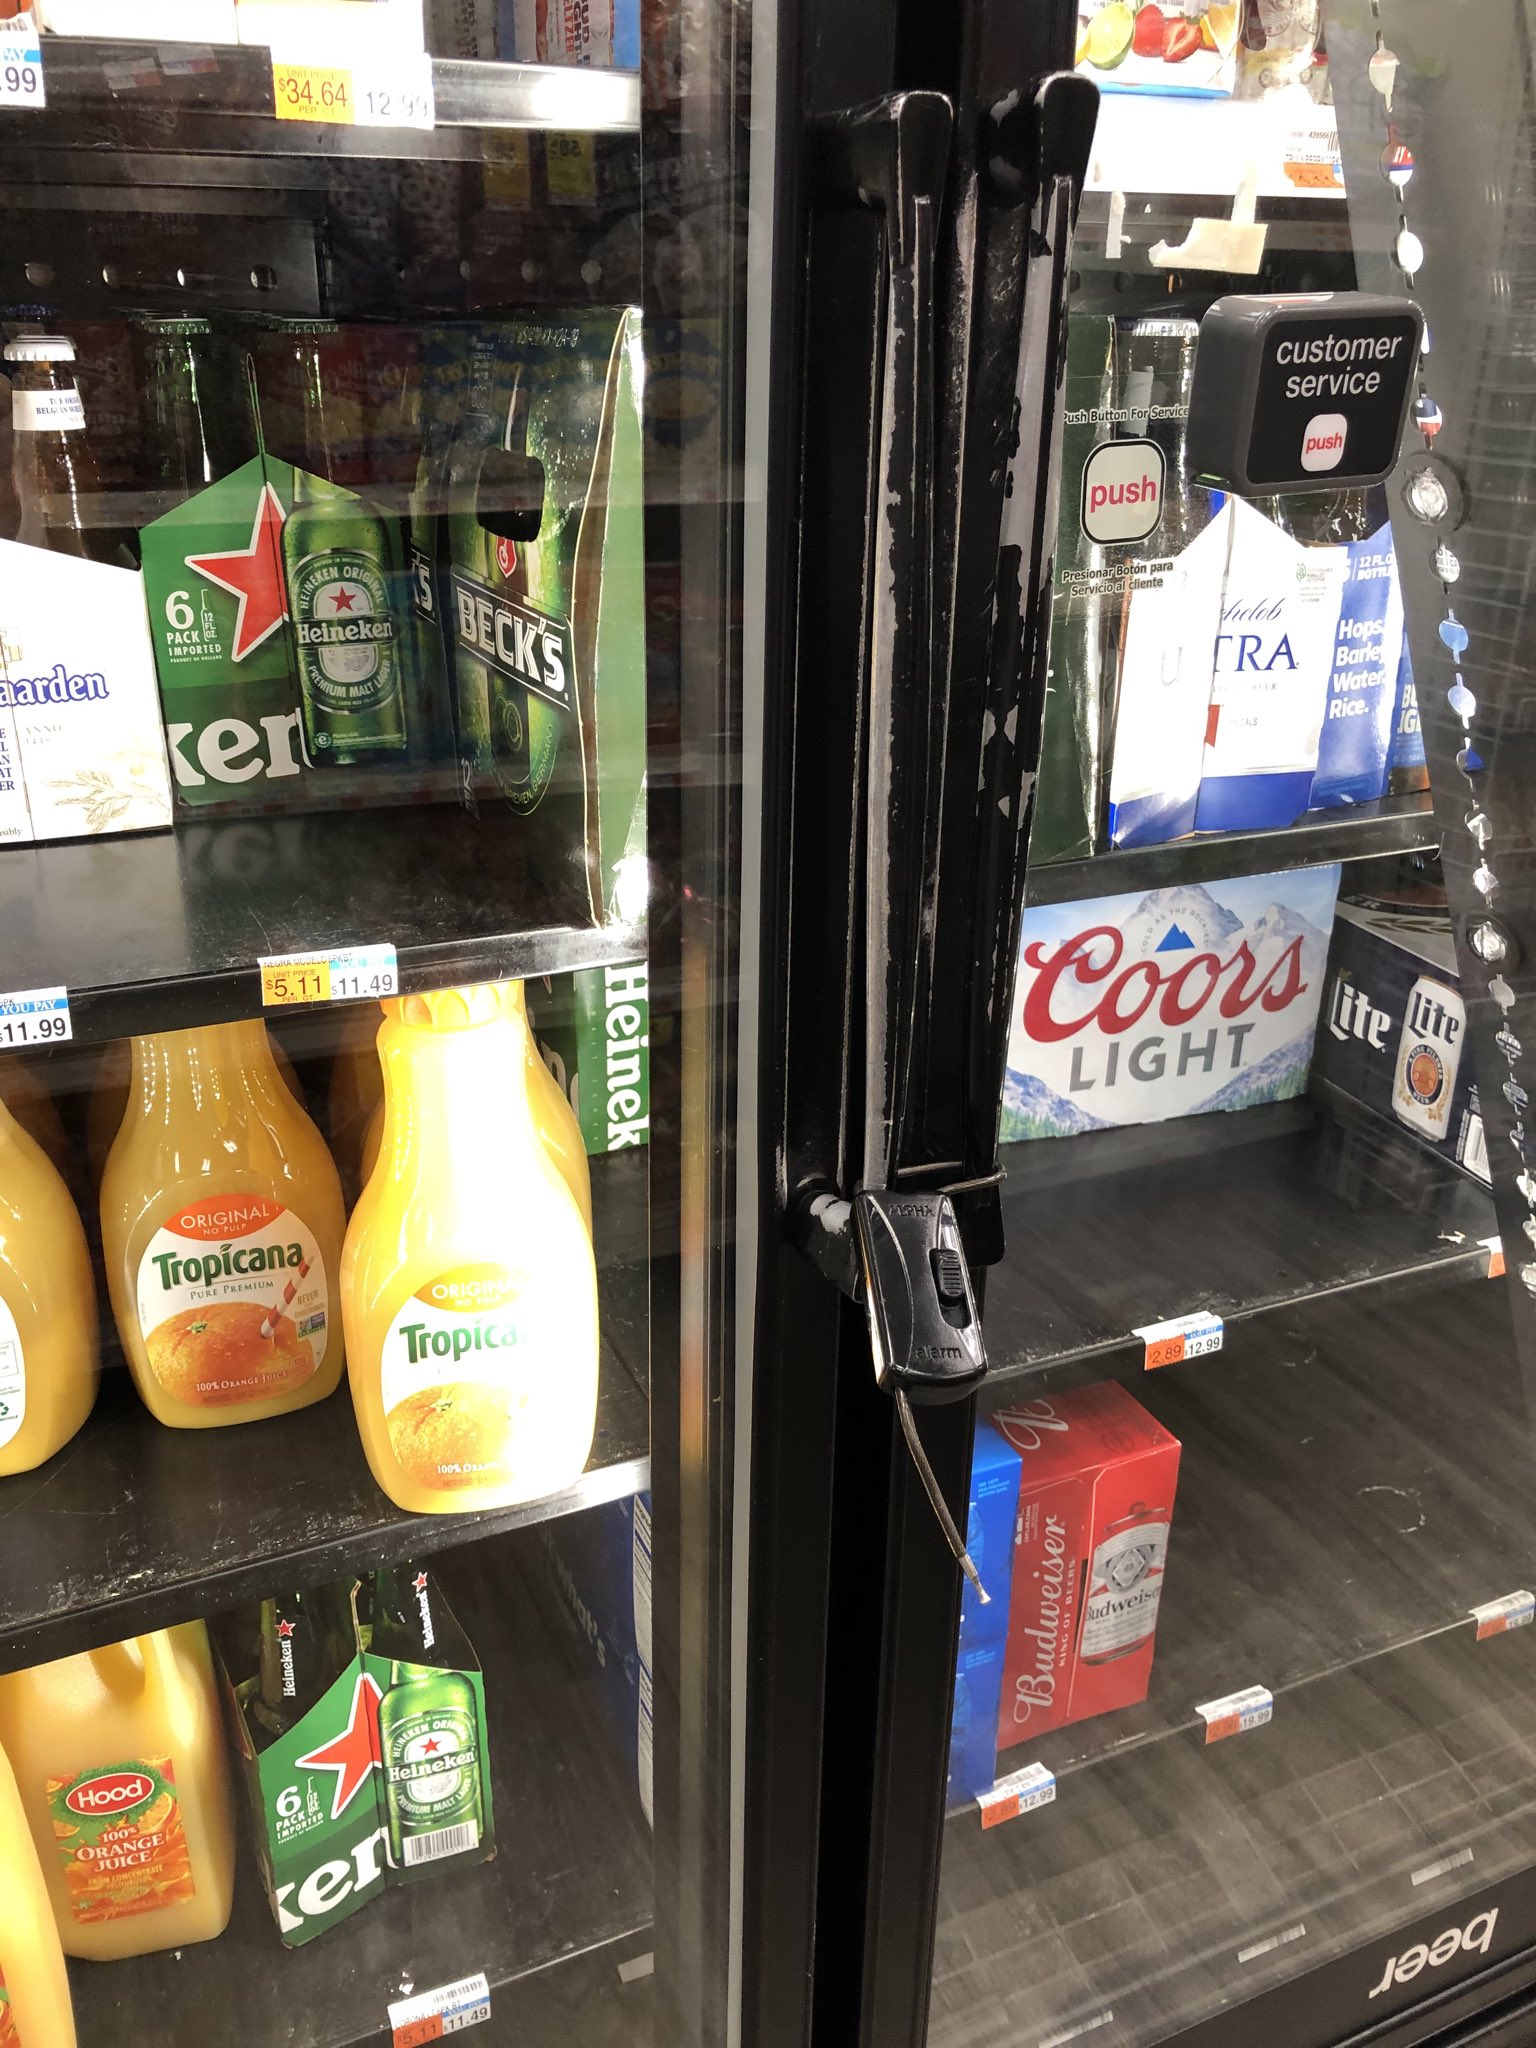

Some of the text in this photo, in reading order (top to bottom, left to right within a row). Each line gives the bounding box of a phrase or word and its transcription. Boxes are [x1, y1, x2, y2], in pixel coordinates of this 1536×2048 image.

[278, 78, 347, 107] $34.64
[299, 105, 317, 114] PER
[1276, 334, 1403, 365] customer
[1285, 366, 1380, 399] service
[1090, 408, 1127, 423] Button
[1131, 405, 1149, 420] For
[1150, 403, 1190, 419] Service
[1306, 432, 1343, 454] push
[1090, 475, 1157, 514] push
[1062, 561, 1174, 583] Presionar Botón para
[301, 566, 339, 611] HEINEKEN
[1071, 577, 1163, 598] Servicio al cliente
[166, 590, 195, 630] 6
[204, 612, 215, 622] 12
[166, 630, 200, 645] PACK
[297, 620, 393, 644] Heineken
[457, 586, 565, 693] BECK'S
[168, 643, 222, 657] IMPORTED
[308, 665, 346, 697] PREMIUM
[349, 682, 374, 698] MALT
[1329, 699, 1369, 719] Rice.
[266, 974, 392, 997] $5.11 $11.49
[273, 970, 290, 978] UNIT
[1023, 925, 1309, 1043] Coors
[1, 1000, 56, 1015] YOU PAY
[1329, 976, 1390, 1052] Lite
[1408, 991, 1459, 1045] Lite
[1069, 1022, 1256, 1093] LIGHT
[180, 1203, 270, 1229] ORIGINAL
[888, 1203, 936, 1218] ALPHA
[203, 1223, 246, 1236] NO PULP
[152, 1243, 304, 1291] Tropicana
[297, 1289, 318, 1304] NEVER
[916, 1344, 963, 1359] alarm
[196, 1380, 219, 1392] 100%
[437, 1464, 461, 1474] 100%
[418, 1590, 436, 1649] Heineken
[1014, 1514, 1067, 1723] Budweiser
[1063, 1611, 1072, 1629] OF
[1058, 1633, 1069, 1667] KING
[280, 1640, 297, 1697] Heineken
[393, 1723, 429, 1758] HEINEKEN
[389, 1750, 475, 1783] Heineken
[77, 1779, 142, 1808] Hood
[276, 1786, 301, 1817] 6
[397, 1795, 430, 1814] PREMIUM
[433, 1797, 455, 1812] MALT
[276, 1810, 305, 1831] PACK
[277, 1812, 323, 1839] IMPORTED
[77, 1834, 164, 1861] ORANGE
[102, 1827, 137, 1843] 100%
[94, 1850, 151, 1872] JUICE
[1368, 1908, 1500, 1999] beer
[444, 2006, 488, 2032] $11.49
